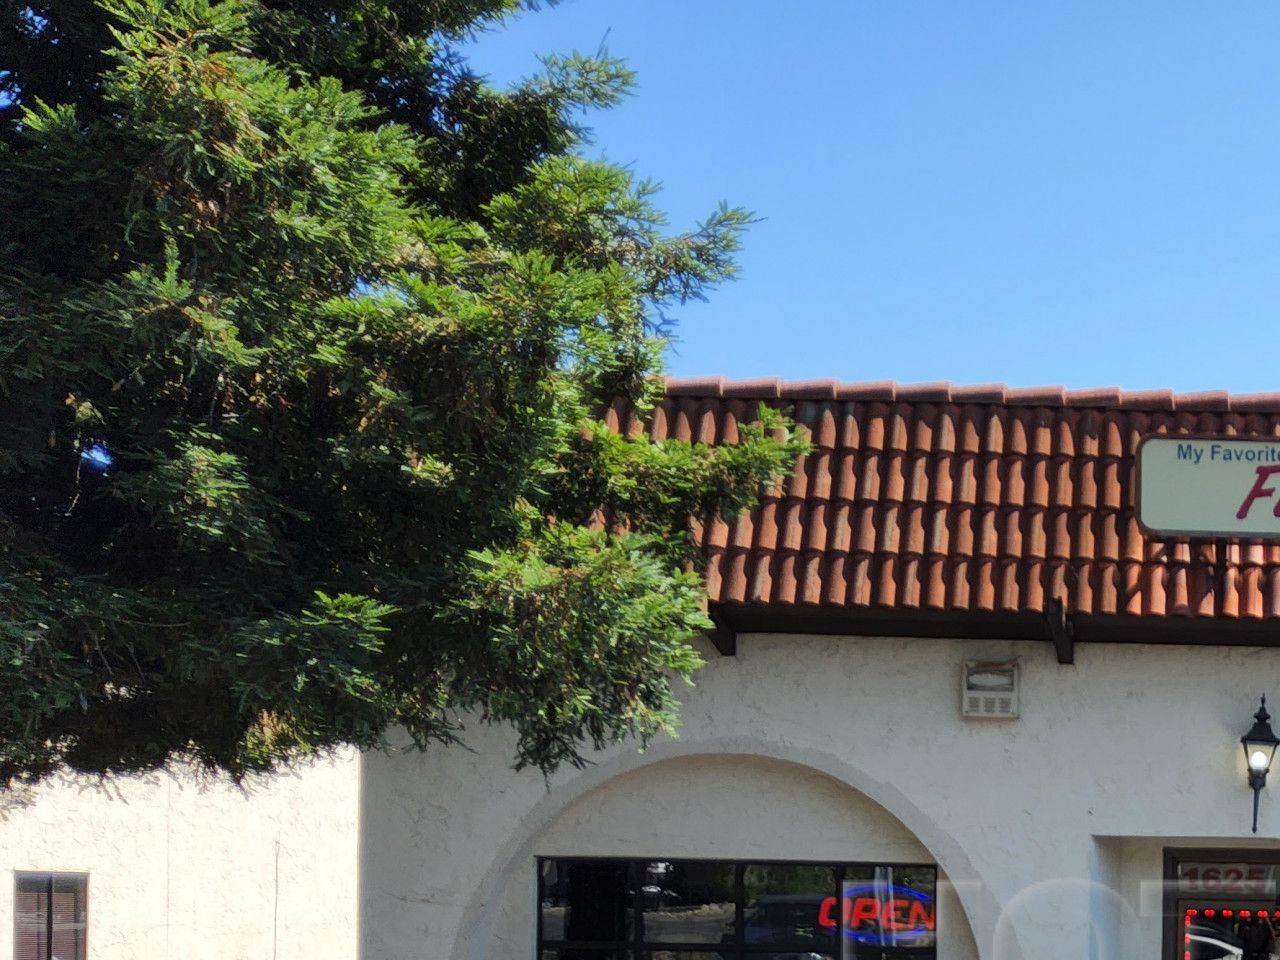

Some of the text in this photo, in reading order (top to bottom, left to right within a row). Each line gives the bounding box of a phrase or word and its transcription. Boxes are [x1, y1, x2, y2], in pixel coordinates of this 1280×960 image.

[1177, 444, 1203, 464] My
[1184, 868, 1265, 893] 1625
[818, 897, 936, 930] OPEN
